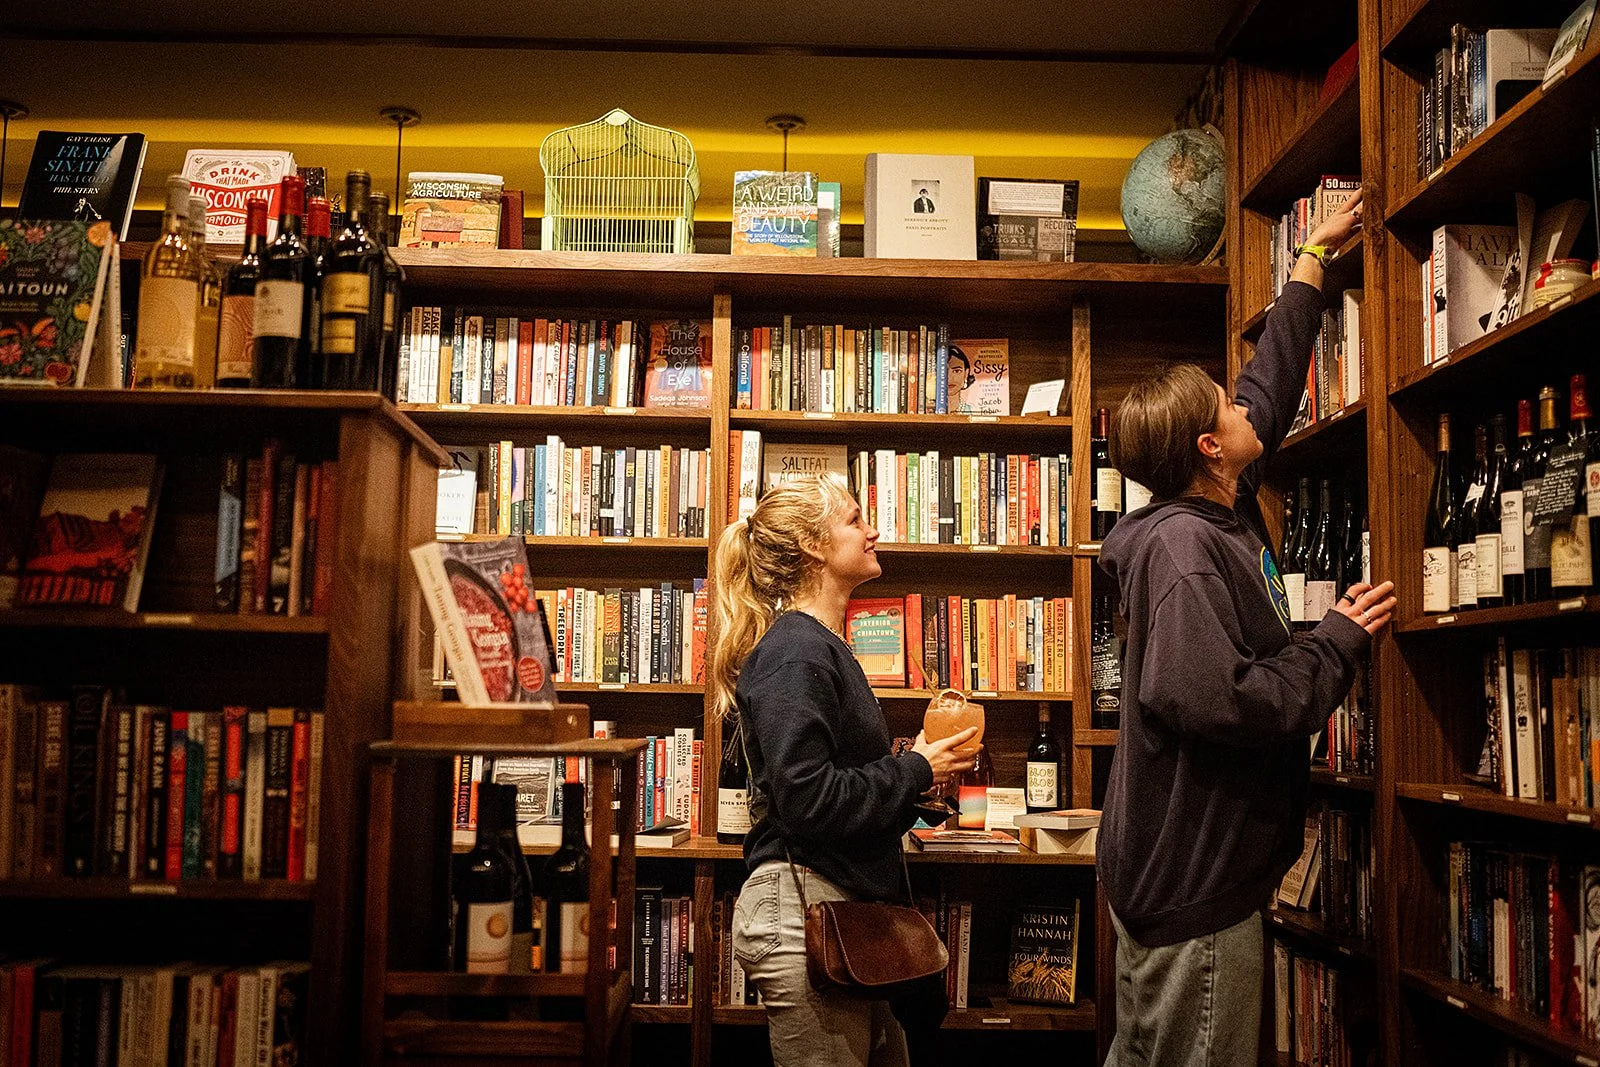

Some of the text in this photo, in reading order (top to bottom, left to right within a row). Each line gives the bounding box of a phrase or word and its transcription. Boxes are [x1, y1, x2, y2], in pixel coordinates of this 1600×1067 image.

[209, 167, 260, 180] DRINK
[1326, 178, 1338, 188] 50
[411, 190, 482, 199] AGRICULTURE
[740, 185, 814, 202] A WEIRD
[740, 202, 812, 216] AND WILD
[740, 216, 810, 233] BEAUTY
[993, 224, 1025, 236] TRUNKS
[423, 311, 432, 336] FAKE
[432, 311, 440, 336] FAKE
[670, 330, 696, 340] The
[660, 344, 702, 356] House
[481, 338, 493, 391] BOOTH
[598, 354, 606, 374] DAVID
[740, 344, 750, 385] California
[974, 360, 1007, 382] Sissy
[598, 374, 606, 396] SIMON
[978, 398, 1002, 406] Jacob
[662, 591, 670, 605] Life
[558, 606, 566, 660] TREEBORNE
[662, 620, 670, 646] Scratch
[621, 634, 630, 668] Mockingbird
[152, 720, 166, 752] JUNE
[1022, 913, 1069, 926] KRISTIN
[1018, 927, 1072, 940] HANNAH
[1014, 952, 1072, 965] FOUR WINDS
[662, 964, 668, 974] my
